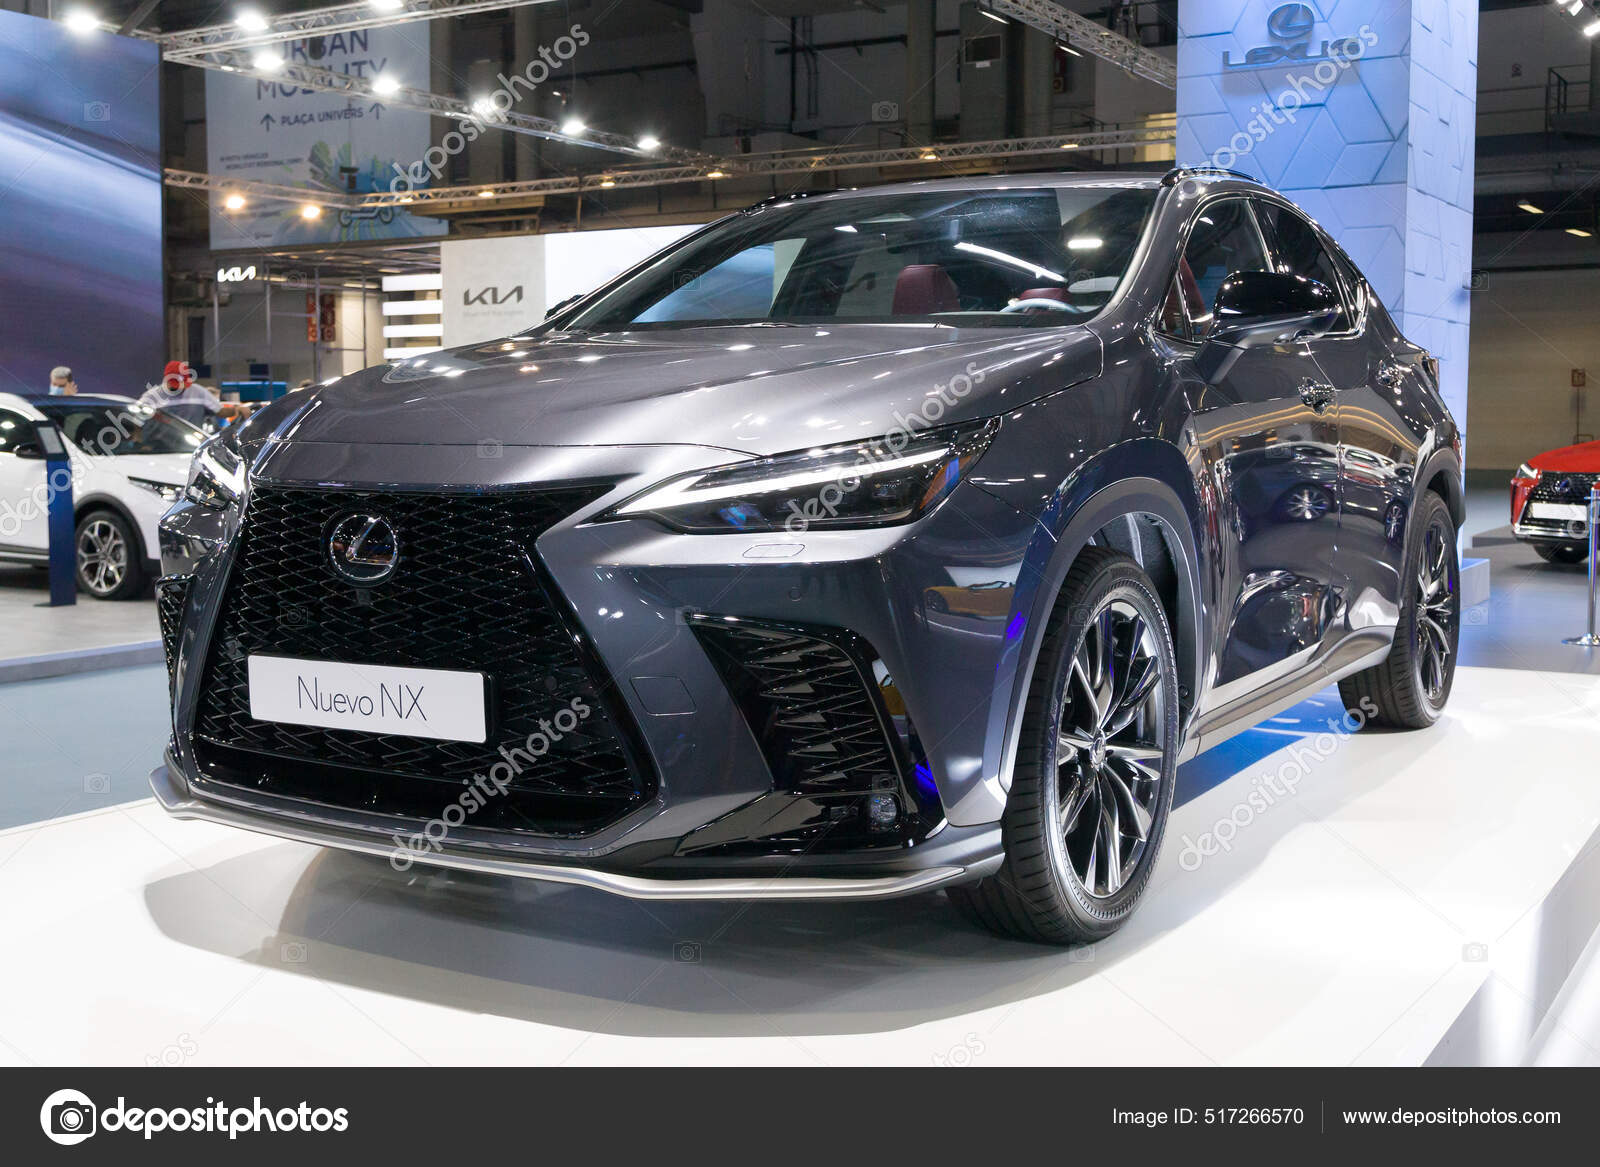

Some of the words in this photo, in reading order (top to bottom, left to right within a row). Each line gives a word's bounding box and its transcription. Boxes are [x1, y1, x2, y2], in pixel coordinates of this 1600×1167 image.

[272, 29, 368, 61] RAN
[256, 57, 387, 100] MOITY
[464, 285, 523, 306] KIA
[297, 675, 374, 716] Nuevo
[380, 682, 428, 722] NX
